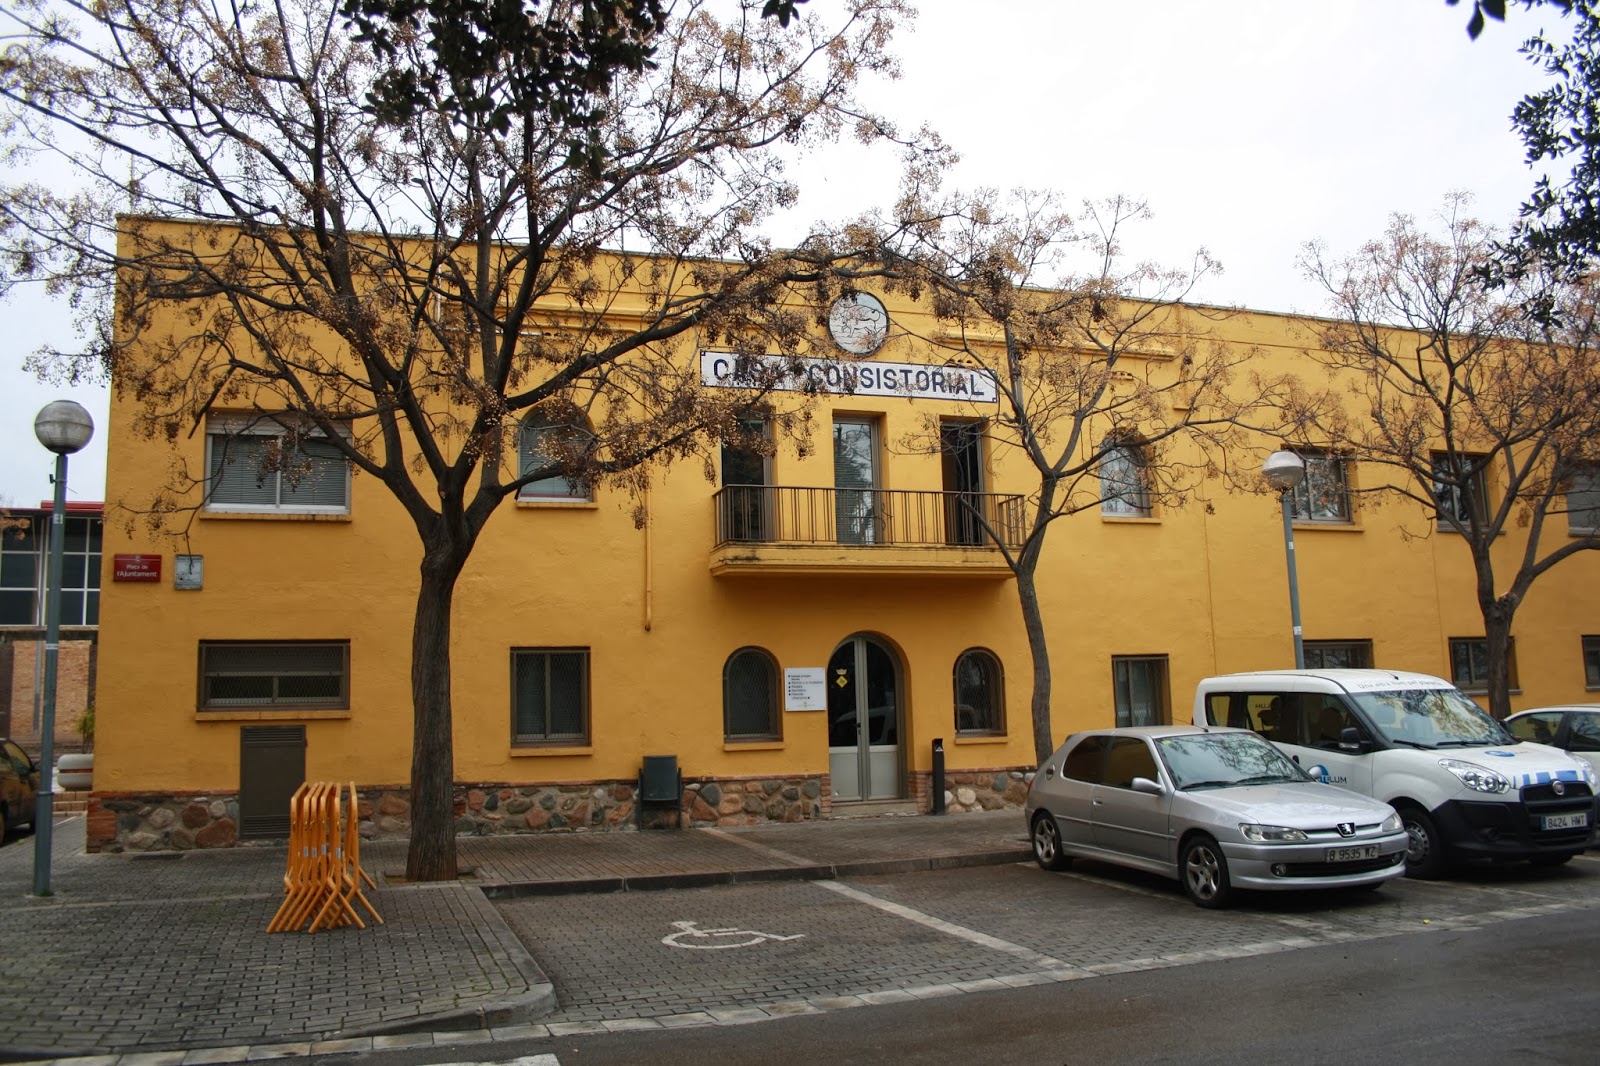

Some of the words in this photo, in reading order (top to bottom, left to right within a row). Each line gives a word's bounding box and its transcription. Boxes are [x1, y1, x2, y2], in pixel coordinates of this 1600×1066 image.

[1547, 816, 1568, 829] 8424
[1329, 850, 1336, 861] B
[1339, 847, 1361, 860] 9535
